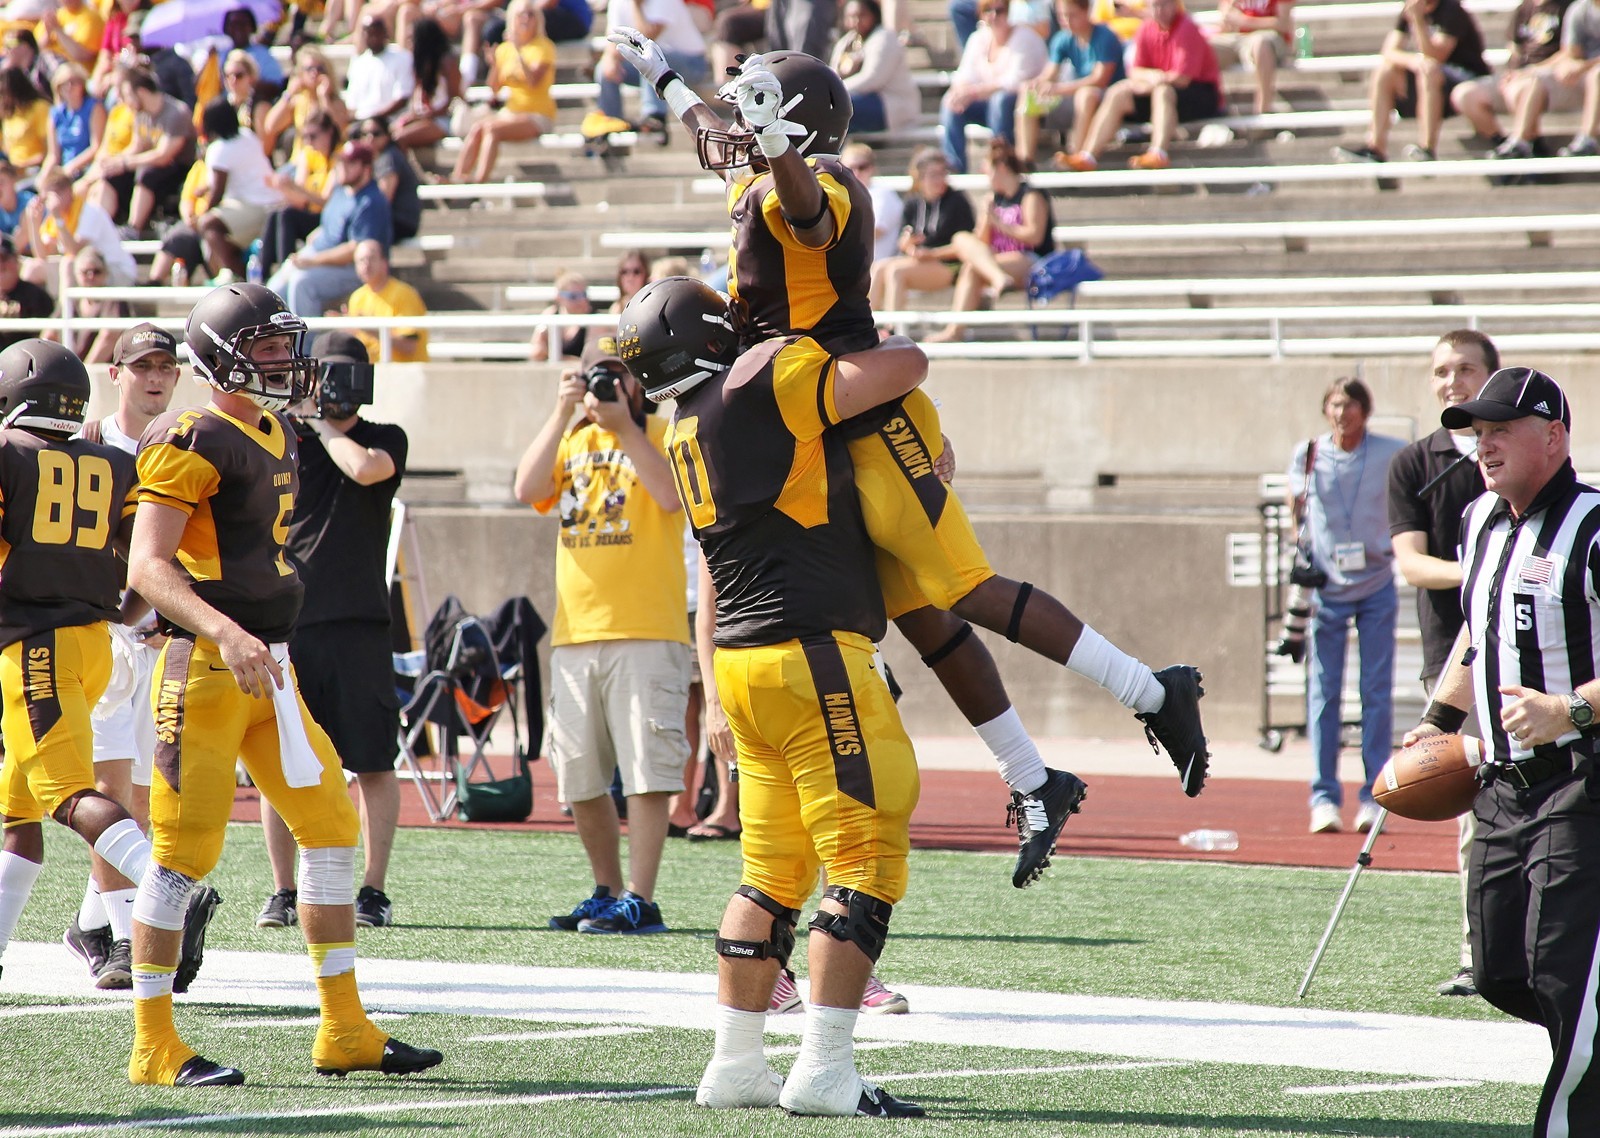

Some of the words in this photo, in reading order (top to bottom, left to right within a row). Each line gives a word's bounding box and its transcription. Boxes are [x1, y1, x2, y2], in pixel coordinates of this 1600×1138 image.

[166, 410, 204, 437] 5
[882, 416, 932, 479] HAWKS
[31, 449, 114, 550] 89
[273, 471, 291, 487] QUINCY
[1515, 603, 1533, 631] S
[28, 646, 54, 702] HAWKS
[156, 679, 182, 745] HAWKS
[824, 692, 862, 756] HAWKS
[729, 945, 755, 956] BREG
